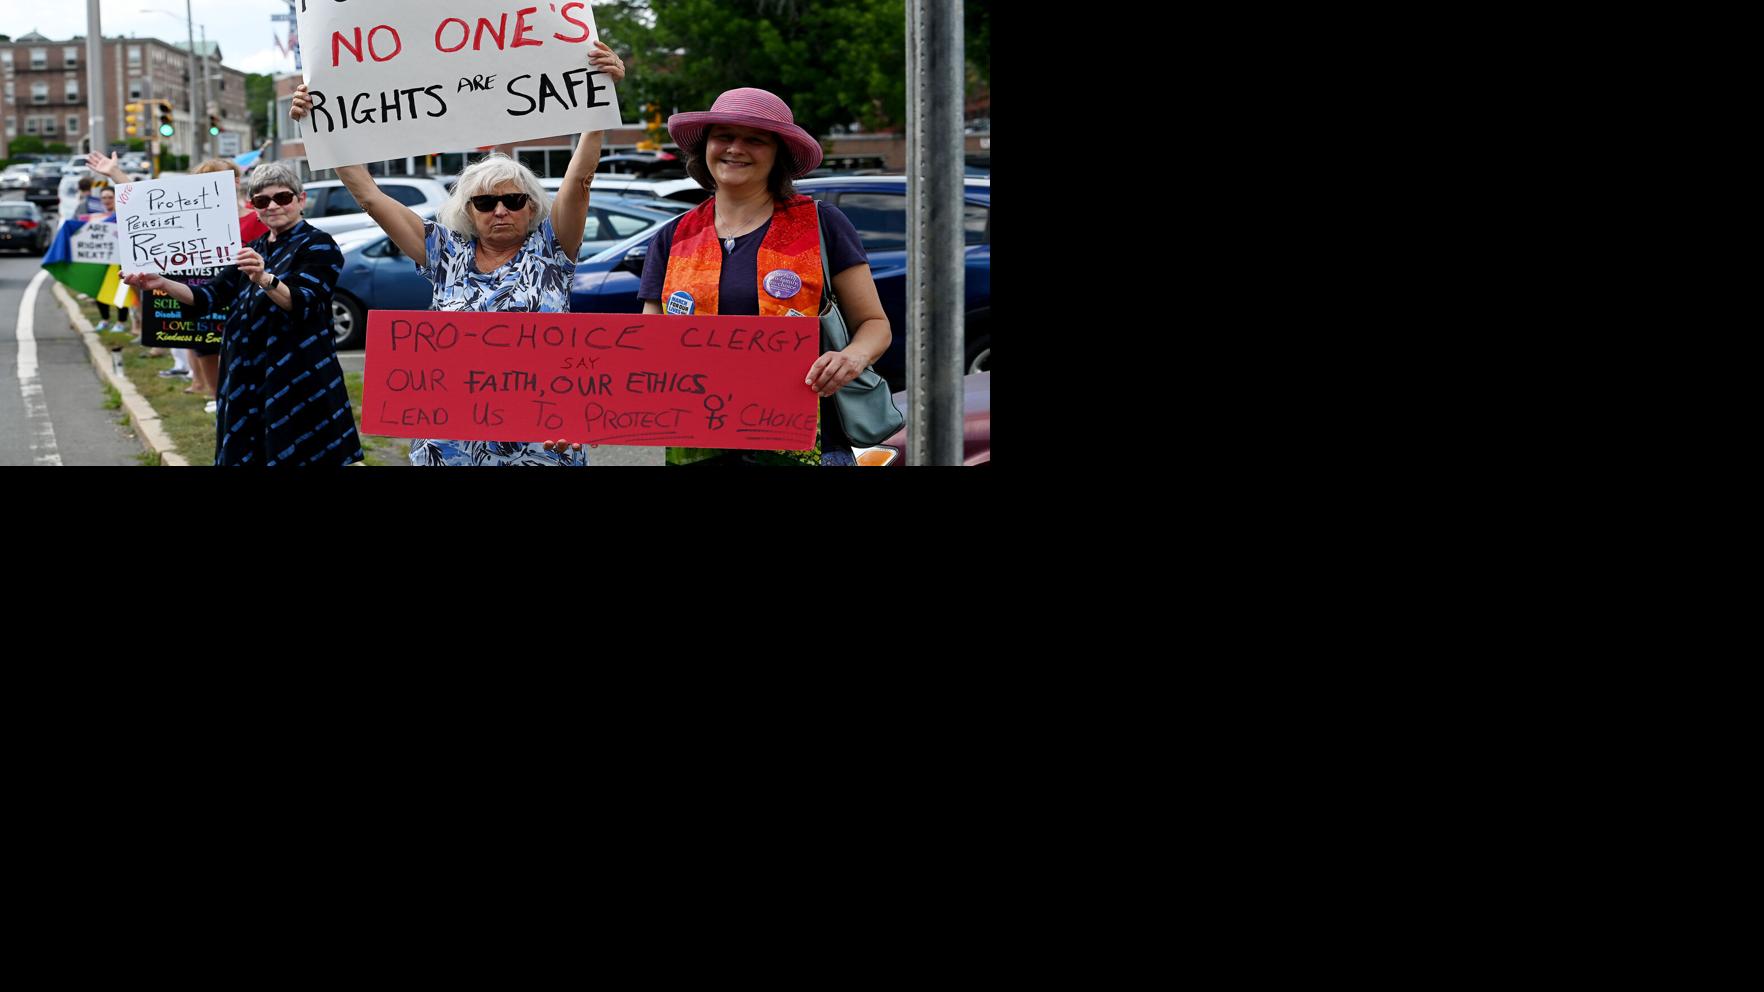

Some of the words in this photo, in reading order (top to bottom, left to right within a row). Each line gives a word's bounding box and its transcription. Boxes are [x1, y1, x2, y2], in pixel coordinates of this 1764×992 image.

[332, 24, 402, 67] NO
[435, 2, 590, 53] ONE'S
[308, 84, 448, 132] RIGHTS
[457, 74, 497, 94] ARE
[507, 68, 610, 116] SAFE
[118, 184, 134, 205] VOTE
[87, 224, 108, 232] ARE
[78, 242, 113, 250] RIGHTS
[130, 233, 207, 262] RESIST
[185, 267, 212, 276] LIVES
[153, 299, 180, 309] SCIE
[162, 321, 194, 331] LOVE
[197, 322, 209, 331] IS
[156, 331, 193, 341] Kindness
[391, 319, 644, 352] PRO-CHOICE
[680, 327, 812, 352] CLERGY
[560, 356, 600, 370] SAY
[386, 368, 447, 391] OUR
[550, 373, 612, 397] OUR
[626, 371, 708, 394] ETHICS
[380, 401, 449, 426] LEAD
[584, 402, 692, 433] PROTECT
[739, 403, 817, 431] CHOICE
